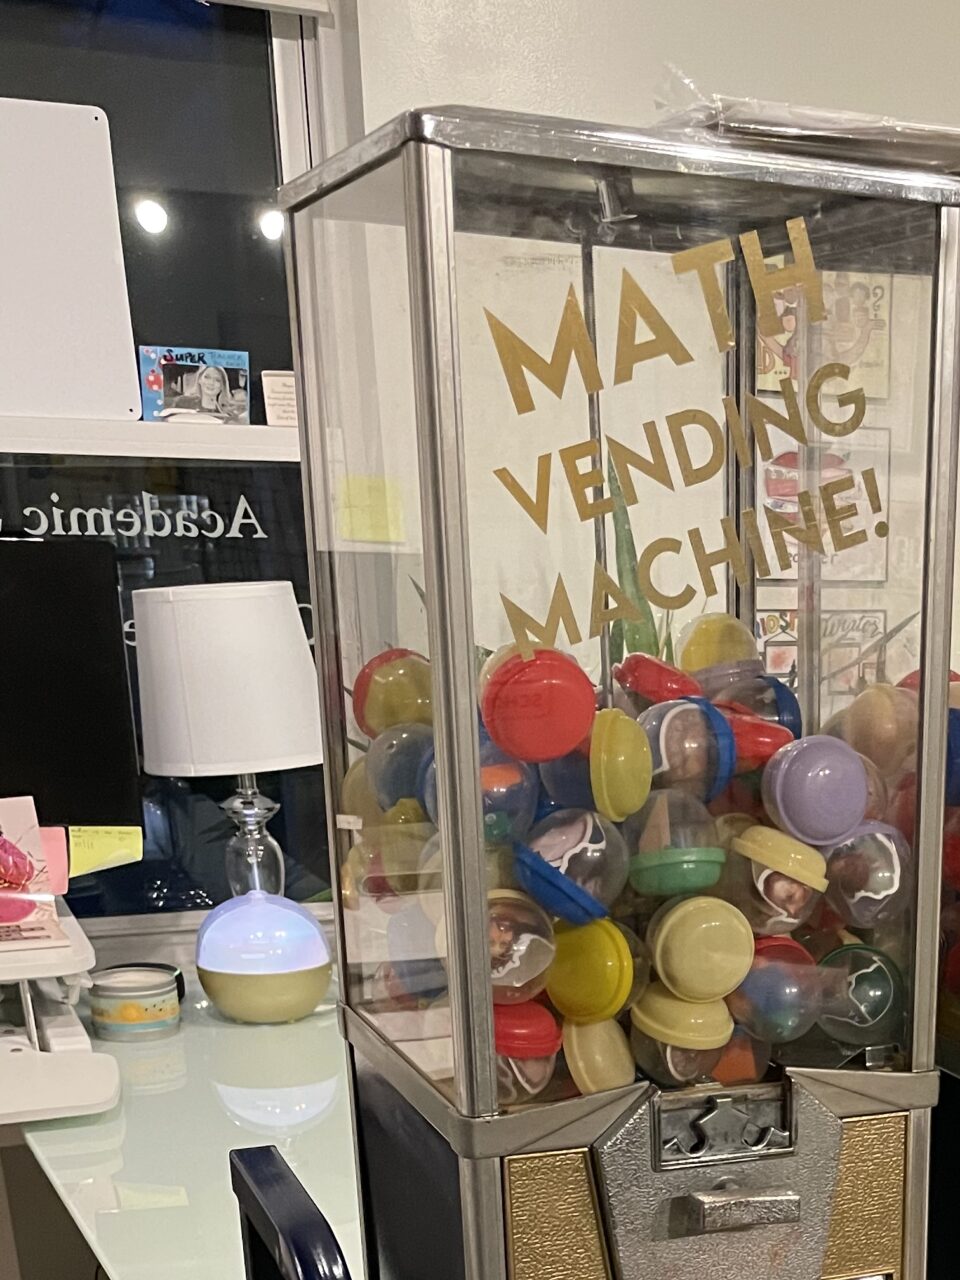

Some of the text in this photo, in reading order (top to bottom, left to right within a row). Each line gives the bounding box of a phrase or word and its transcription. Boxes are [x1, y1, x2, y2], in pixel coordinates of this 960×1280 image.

[164, 348, 207, 365] SUPER
[483, 216, 828, 415] MATH
[493, 361, 867, 535] VENDING
[498, 467, 889, 663] MACHINE!
